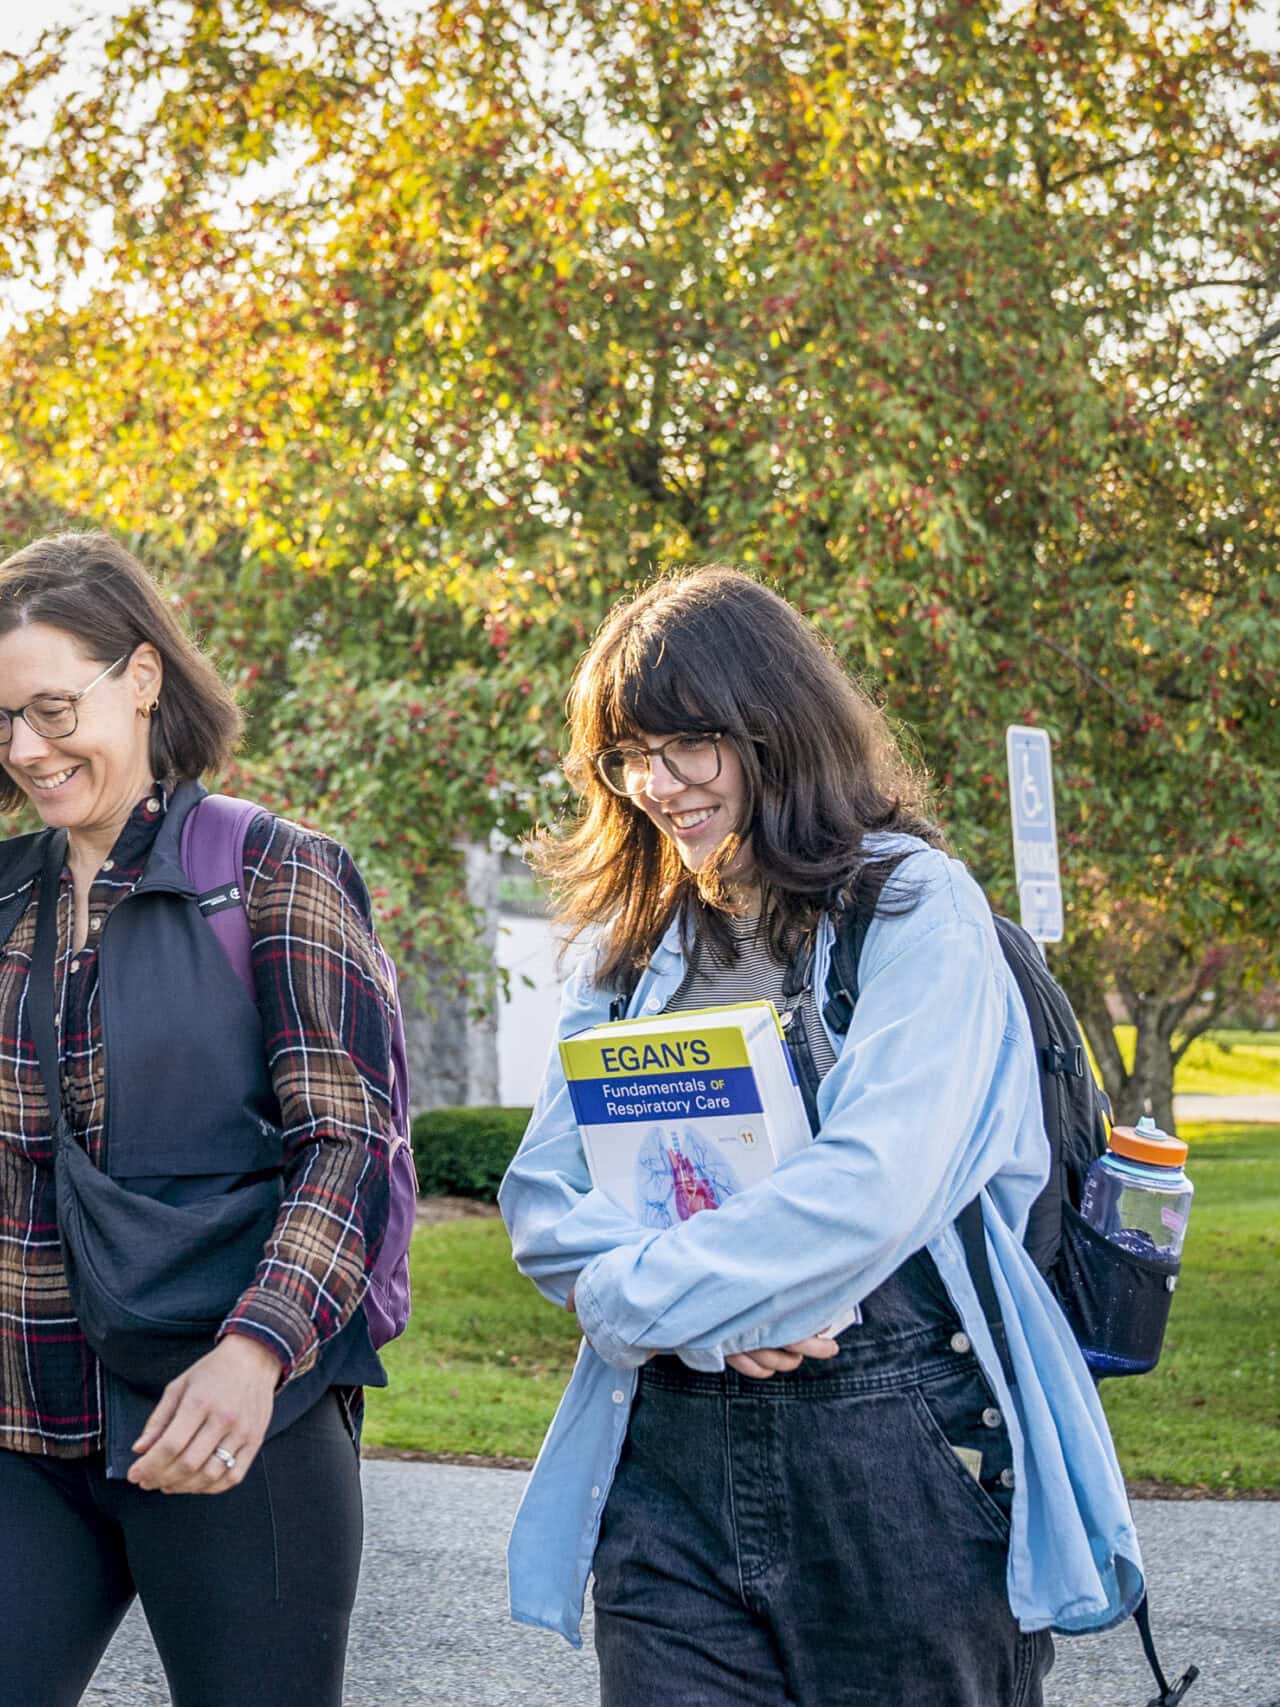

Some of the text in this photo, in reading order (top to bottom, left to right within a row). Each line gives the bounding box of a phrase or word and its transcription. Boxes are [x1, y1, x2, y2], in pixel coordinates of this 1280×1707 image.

[600, 1039, 711, 1073] EGAN'S
[602, 1078, 725, 1098] Fundamentals OF
[606, 1096, 730, 1117] Respiratory Care
